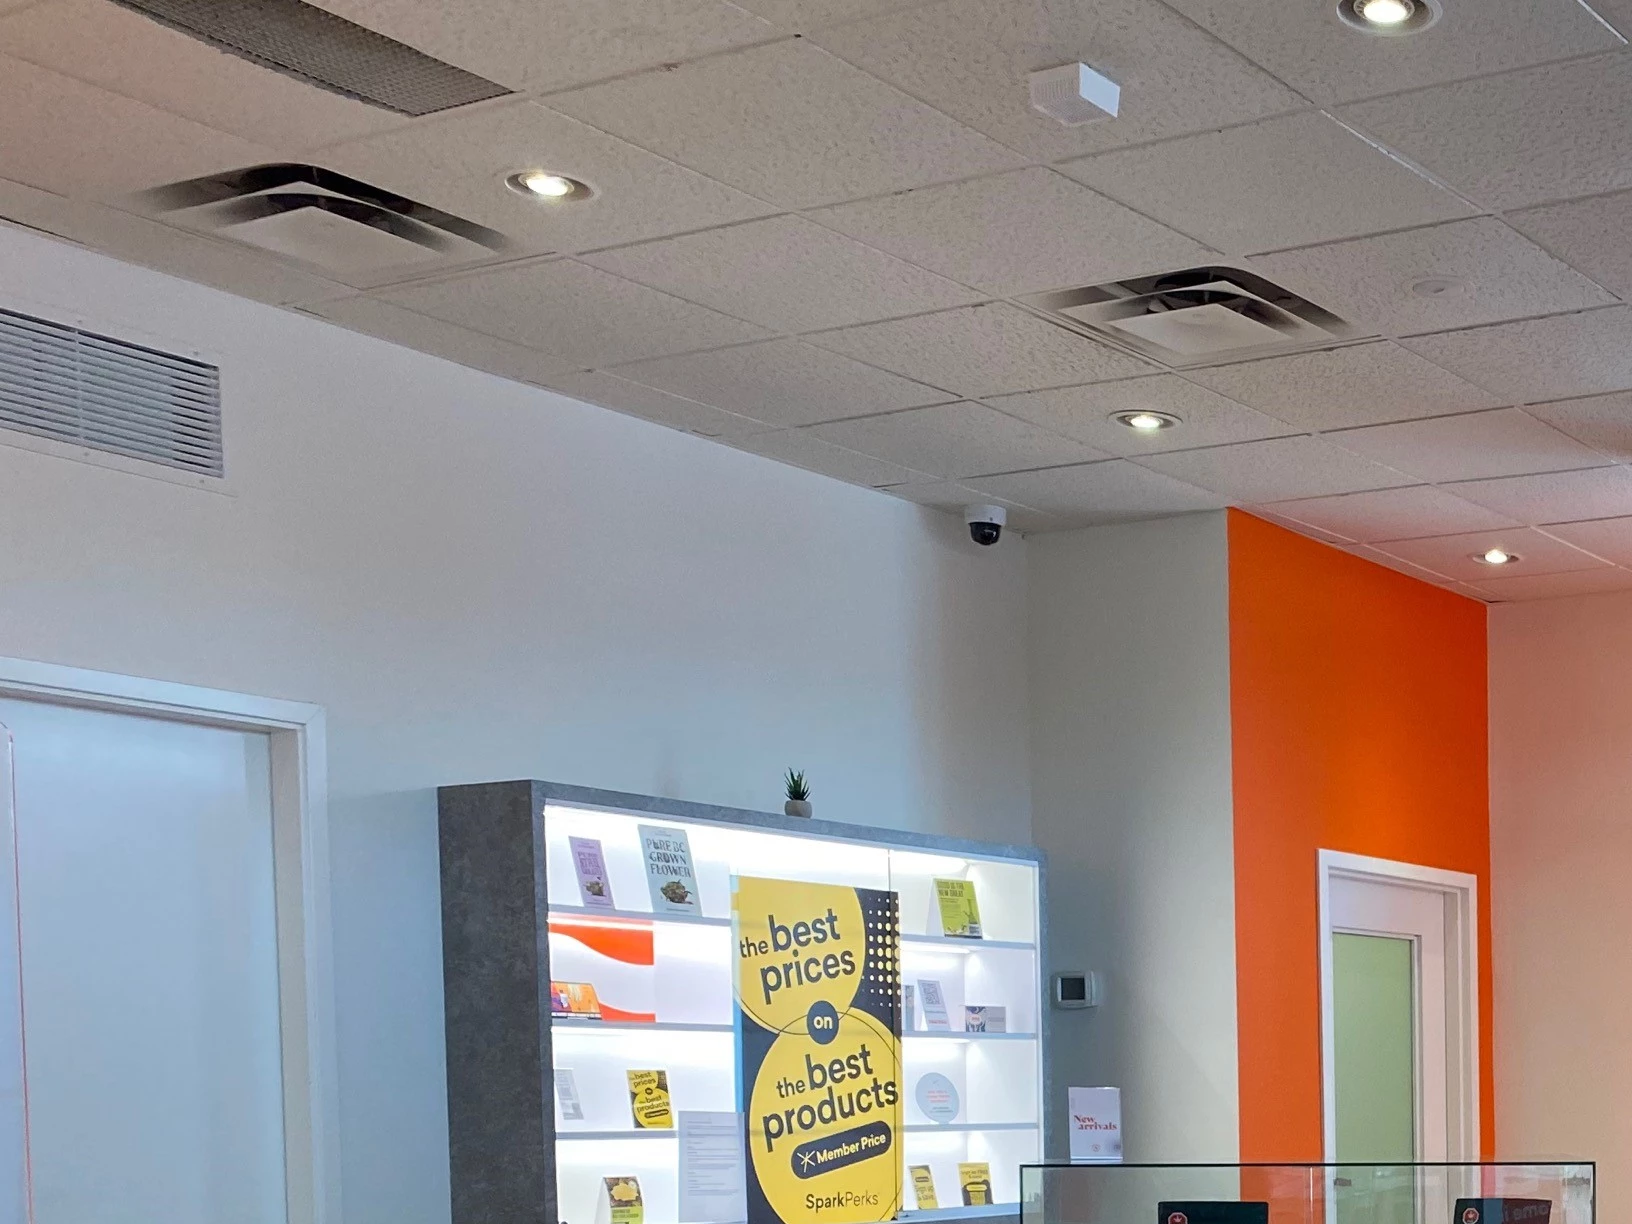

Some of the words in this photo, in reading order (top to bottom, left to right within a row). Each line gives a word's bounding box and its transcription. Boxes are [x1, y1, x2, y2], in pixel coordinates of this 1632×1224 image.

[646, 838, 671, 852] PURE
[672, 840, 686, 853] BC
[649, 851, 687, 865] GROWN
[650, 863, 692, 878] FLOWER
[740, 937, 769, 959] the
[768, 908, 841, 952] best
[760, 949, 856, 1005] prices
[813, 1016, 833, 1030] on
[776, 1077, 806, 1099] the
[805, 1044, 874, 1091] best
[763, 1077, 899, 1153] products
[1073, 1115, 1094, 1123] New
[1078, 1121, 1118, 1130] arrivals
[816, 1141, 860, 1164] Member
[860, 1133, 887, 1150] Price
[806, 1191, 879, 1213] SparkPerks
